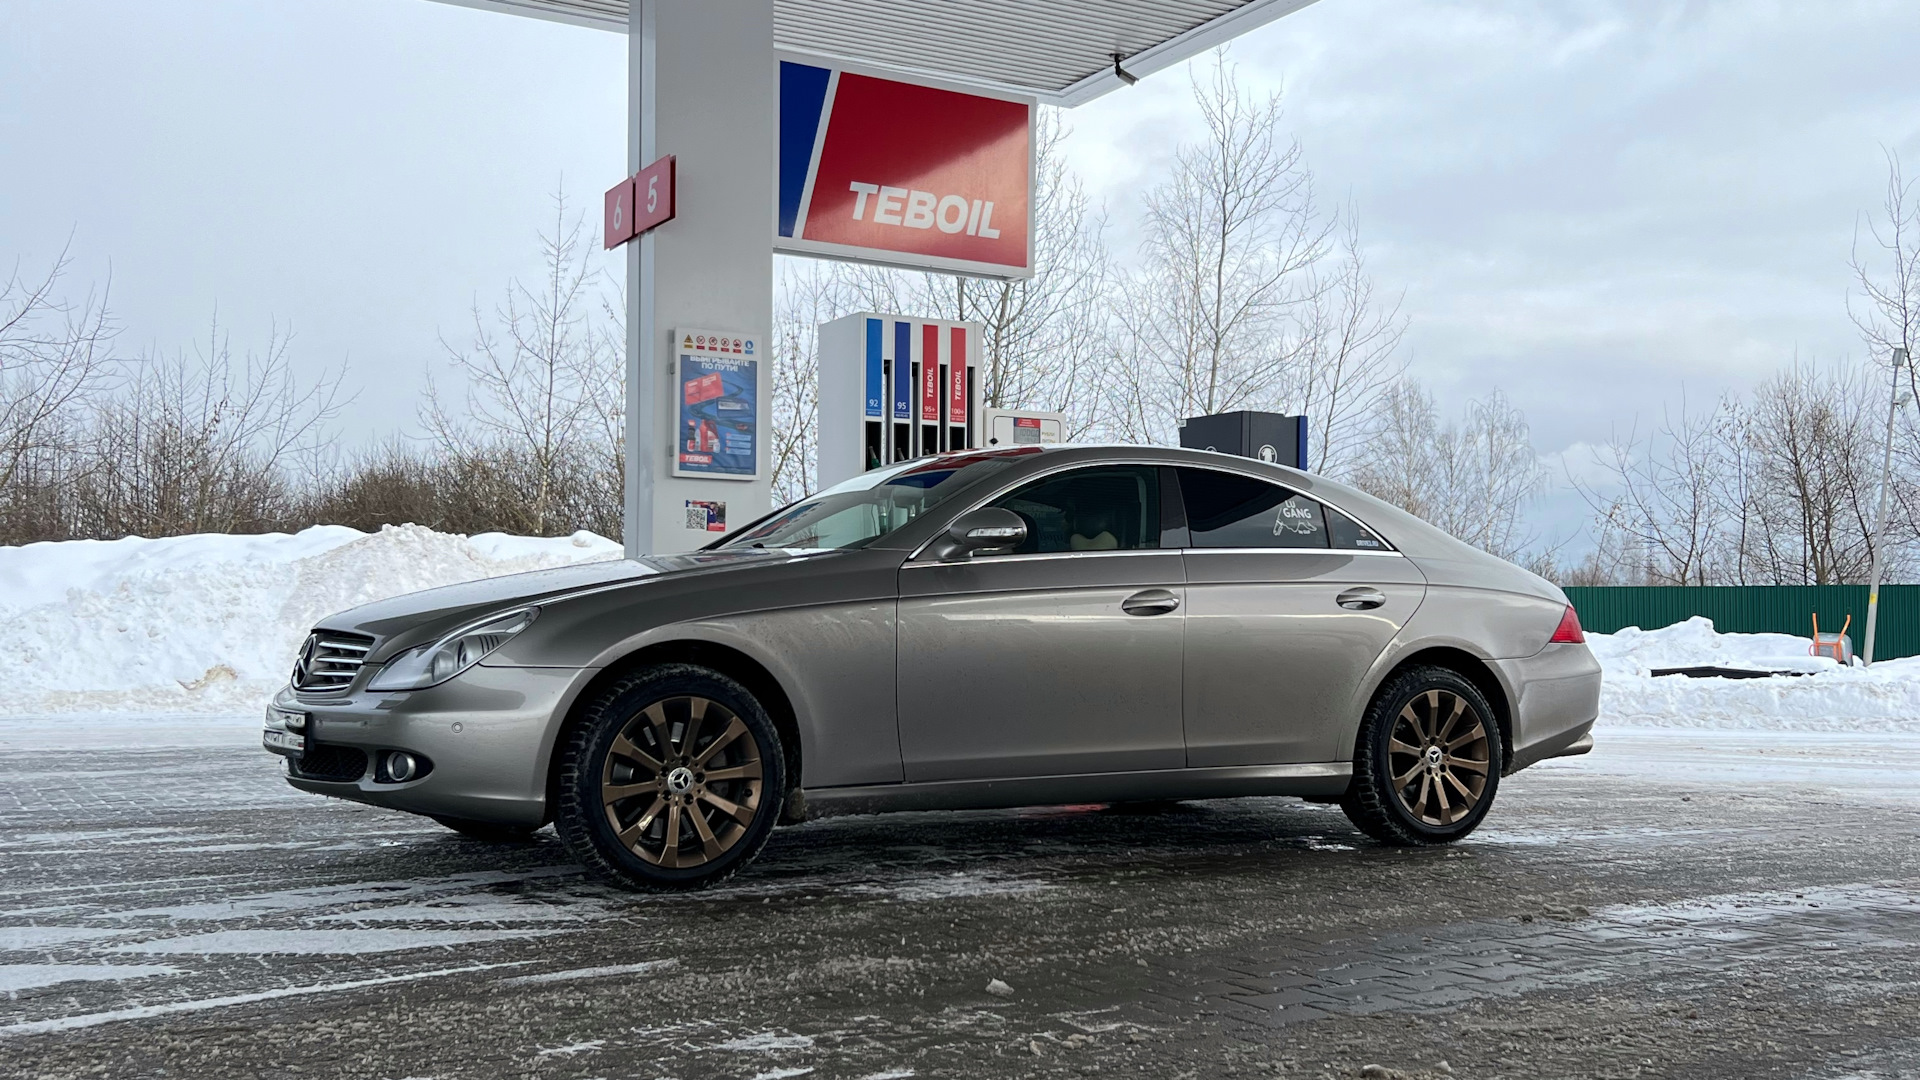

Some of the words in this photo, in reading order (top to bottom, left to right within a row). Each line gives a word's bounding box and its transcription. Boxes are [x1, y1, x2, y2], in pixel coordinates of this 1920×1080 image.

[647, 175, 659, 214] 5
[612, 194, 622, 231] 6
[849, 181, 1001, 240] TEBOIL
[869, 399, 879, 408] 92
[897, 402, 907, 410] 95
[924, 405, 936, 413] 95+
[951, 407, 965, 415] 100+
[685, 455, 709, 464] TEBOIL
[1285, 500, 1295, 509] LU
[1282, 508, 1312, 519] GANG
